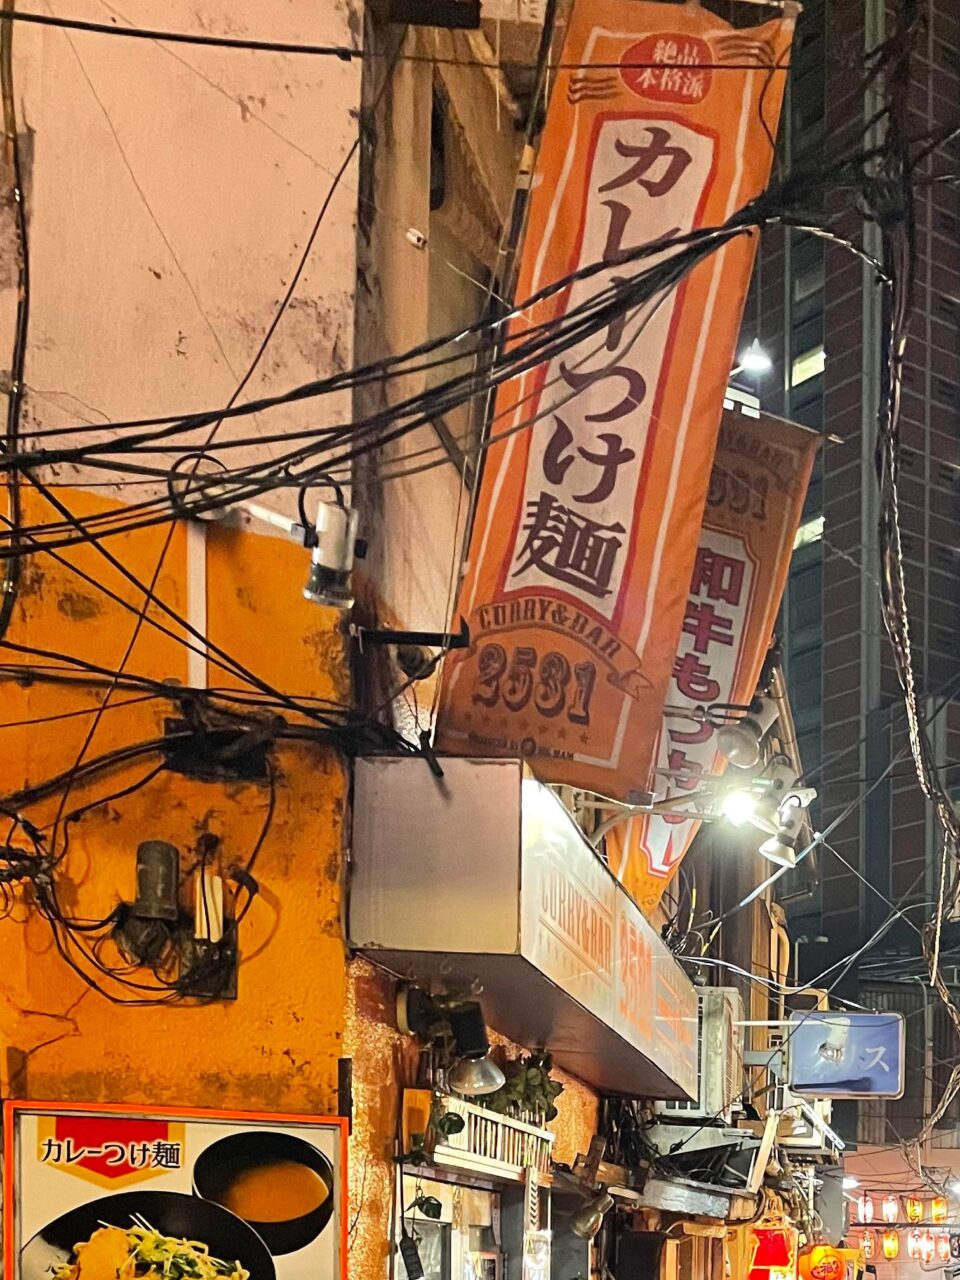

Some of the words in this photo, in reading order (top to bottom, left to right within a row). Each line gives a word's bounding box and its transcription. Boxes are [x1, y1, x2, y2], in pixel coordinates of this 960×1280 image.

[515, 126, 692, 600] カレーつけ麺
[41, 1138, 181, 1169] カレーつけ麺
